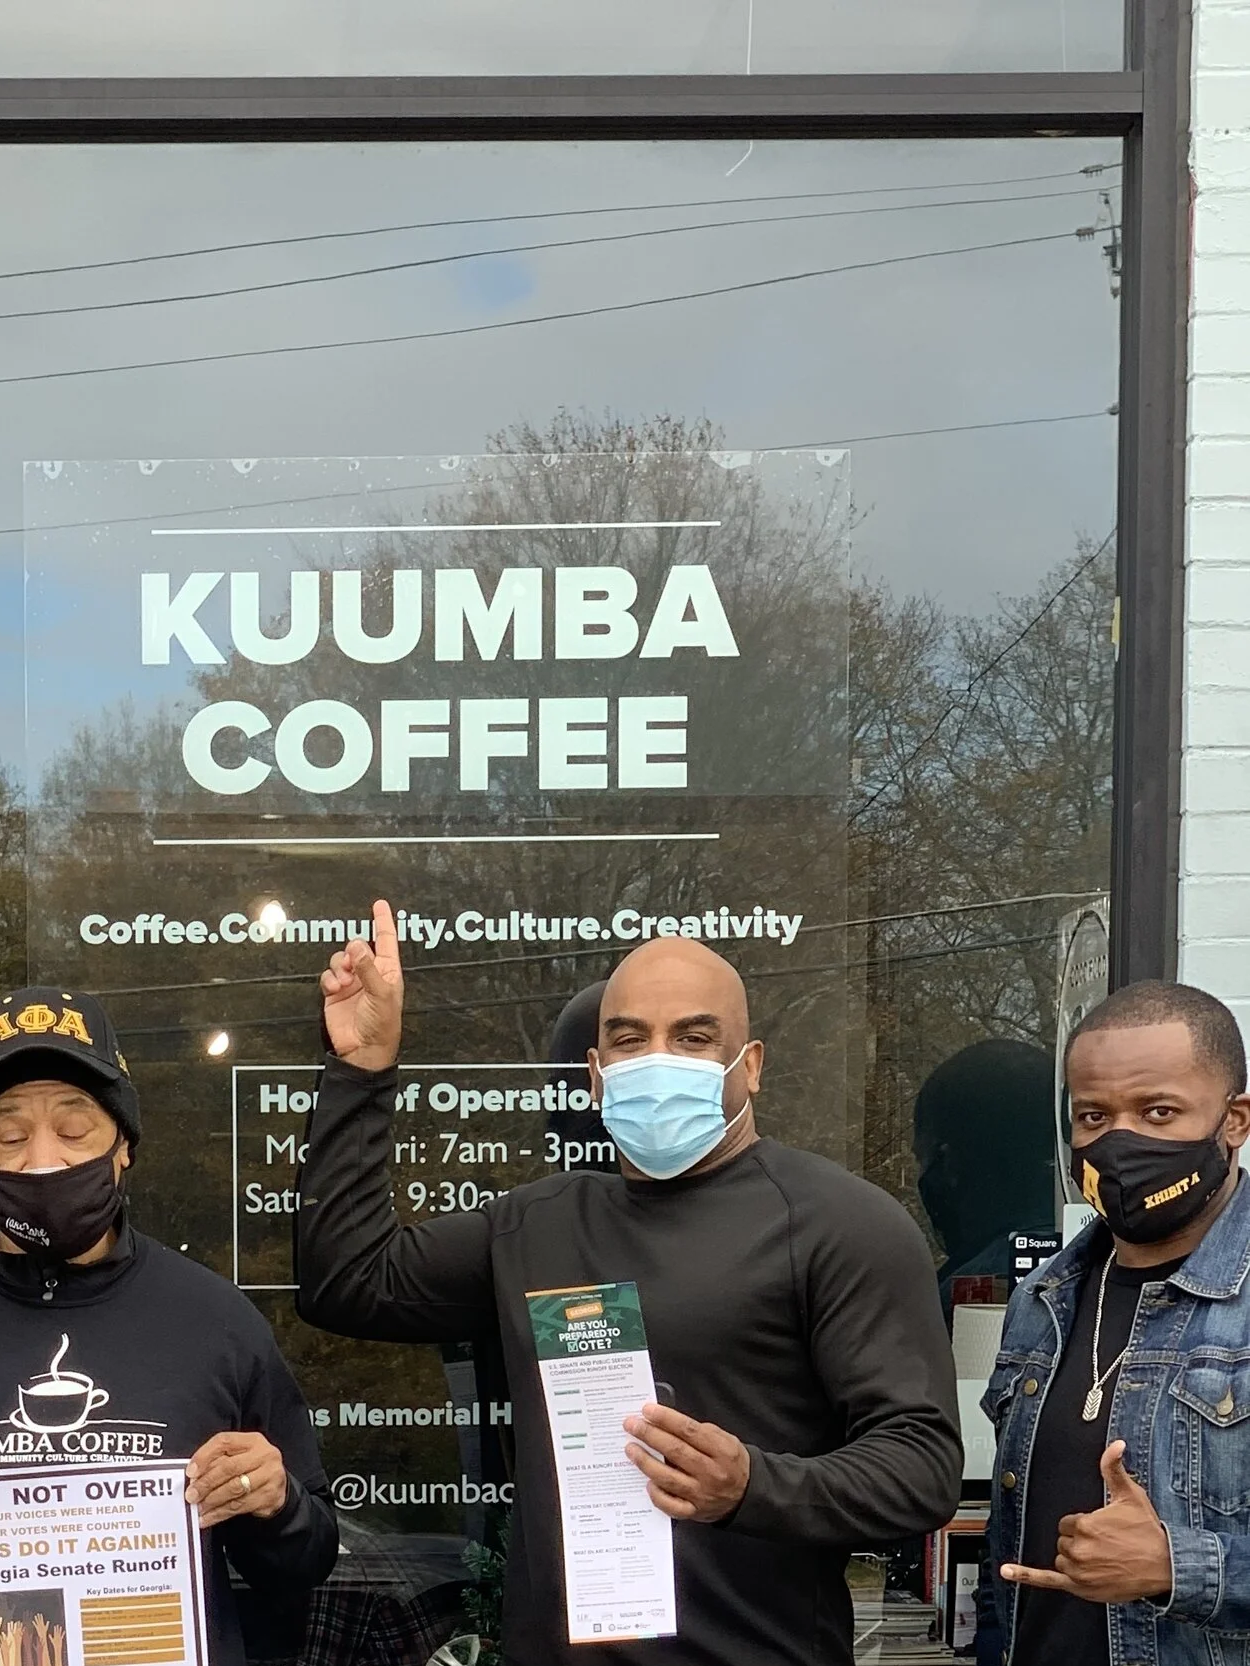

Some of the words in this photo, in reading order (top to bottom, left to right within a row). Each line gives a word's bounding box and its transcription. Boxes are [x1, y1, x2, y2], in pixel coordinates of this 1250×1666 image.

[141, 564, 740, 666] KUUMBA
[181, 695, 688, 795] COFFEE
[428, 1080, 600, 1119] Operatio
[439, 1133, 508, 1164] 7am
[544, 1132, 616, 1171] 3pm
[1028, 1238, 1058, 1249] Square
[558, 1329, 607, 1342] PREPARED
[607, 1328, 621, 1337] TO
[567, 1321, 586, 1332] ARE
[586, 1319, 607, 1330] YOU
[339, 1401, 480, 1427] Memorial
[61, 1431, 164, 1457] COFFEE
[45, 1453, 88, 1463] CULTURE
[13, 1484, 68, 1506] NOT
[84, 1478, 174, 1501] OVER!!
[330, 1473, 516, 1511] @kuumbac
[15, 1509, 57, 1520] VOICES
[59, 1507, 93, 1518] WERE
[96, 1504, 135, 1515] HEARD
[11, 1525, 49, 1537] VOTES
[50, 1523, 83, 1534] WERE
[86, 1519, 142, 1531] COUNTED
[18, 1540, 50, 1557] DO
[57, 1538, 79, 1554] IT
[86, 1532, 177, 1553] AGAIN!!!
[36, 1560, 106, 1578] Senate
[112, 1555, 178, 1574] Runoff
[86, 1588, 101, 1597] Key
[103, 1586, 126, 1595] Dates
[127, 1585, 138, 1593] for
[139, 1583, 173, 1593] Georgia:
